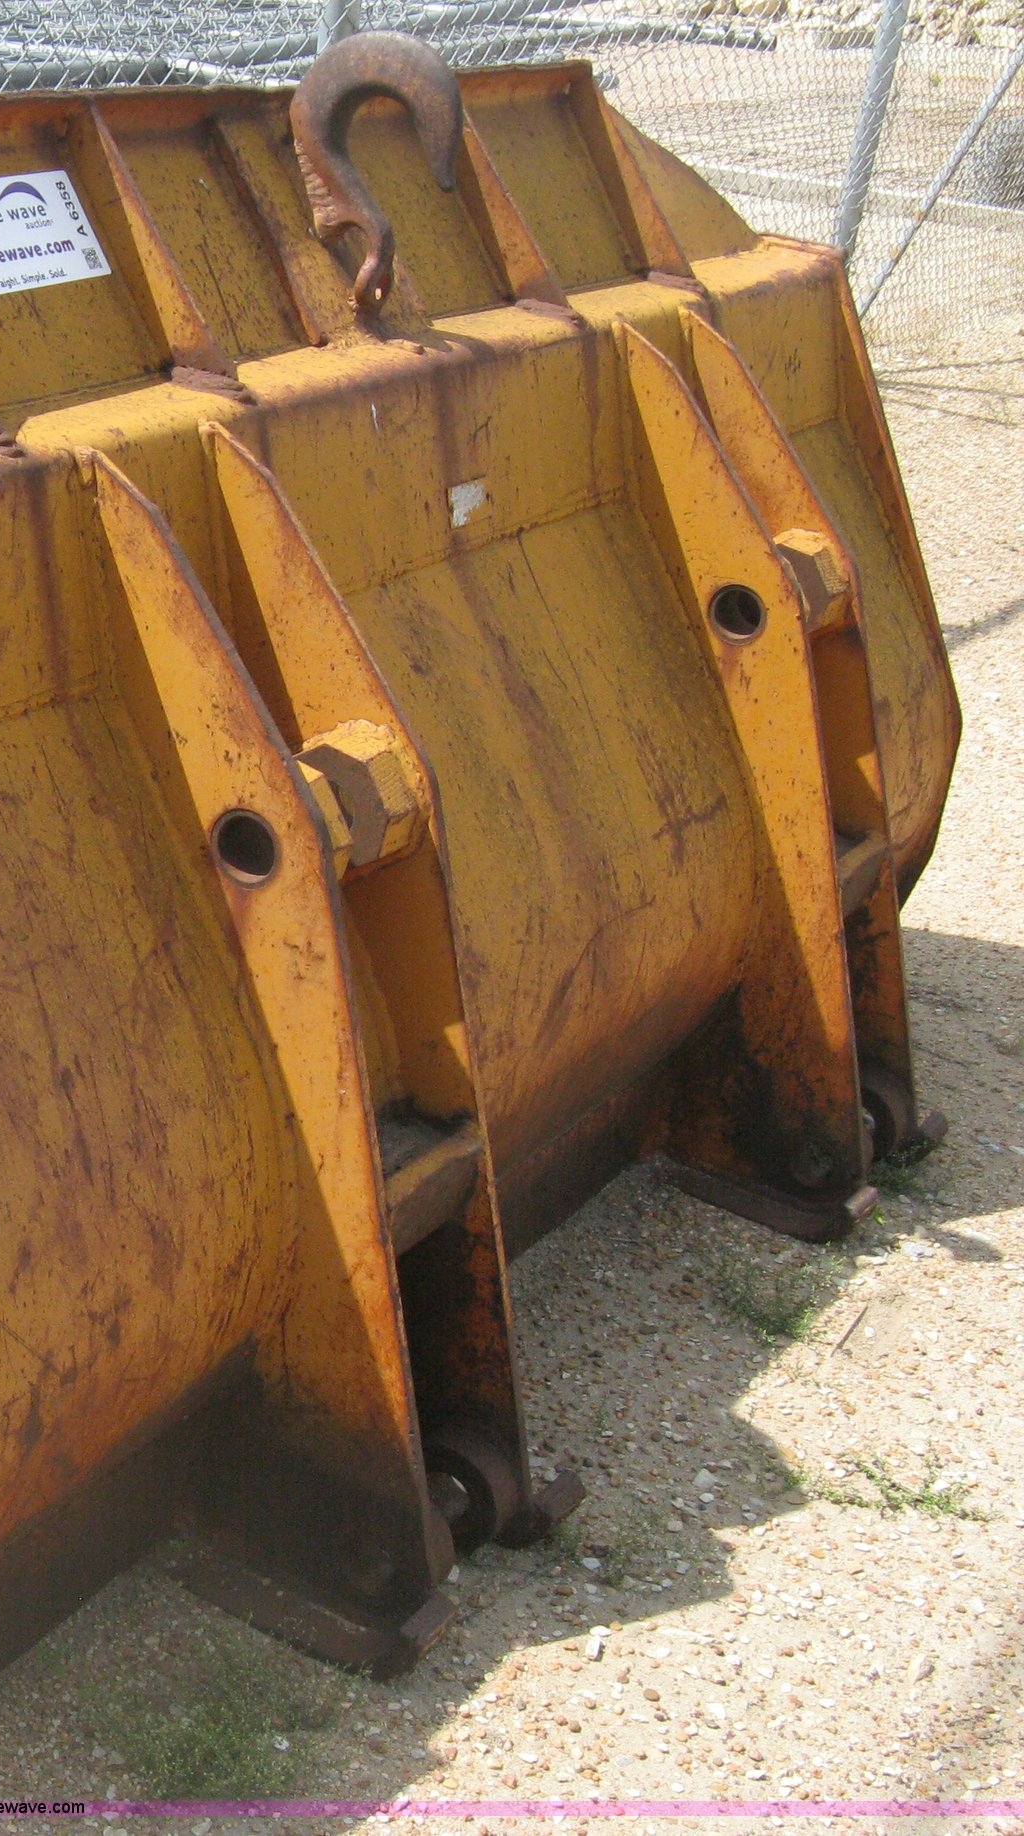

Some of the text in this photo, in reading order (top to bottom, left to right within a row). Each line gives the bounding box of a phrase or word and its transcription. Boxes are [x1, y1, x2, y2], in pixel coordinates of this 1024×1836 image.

[6, 203, 47, 221] wave
[55, 181, 88, 237] A 6358
[21, 270, 49, 284] Simple.
[49, 267, 67, 279] Sold.
